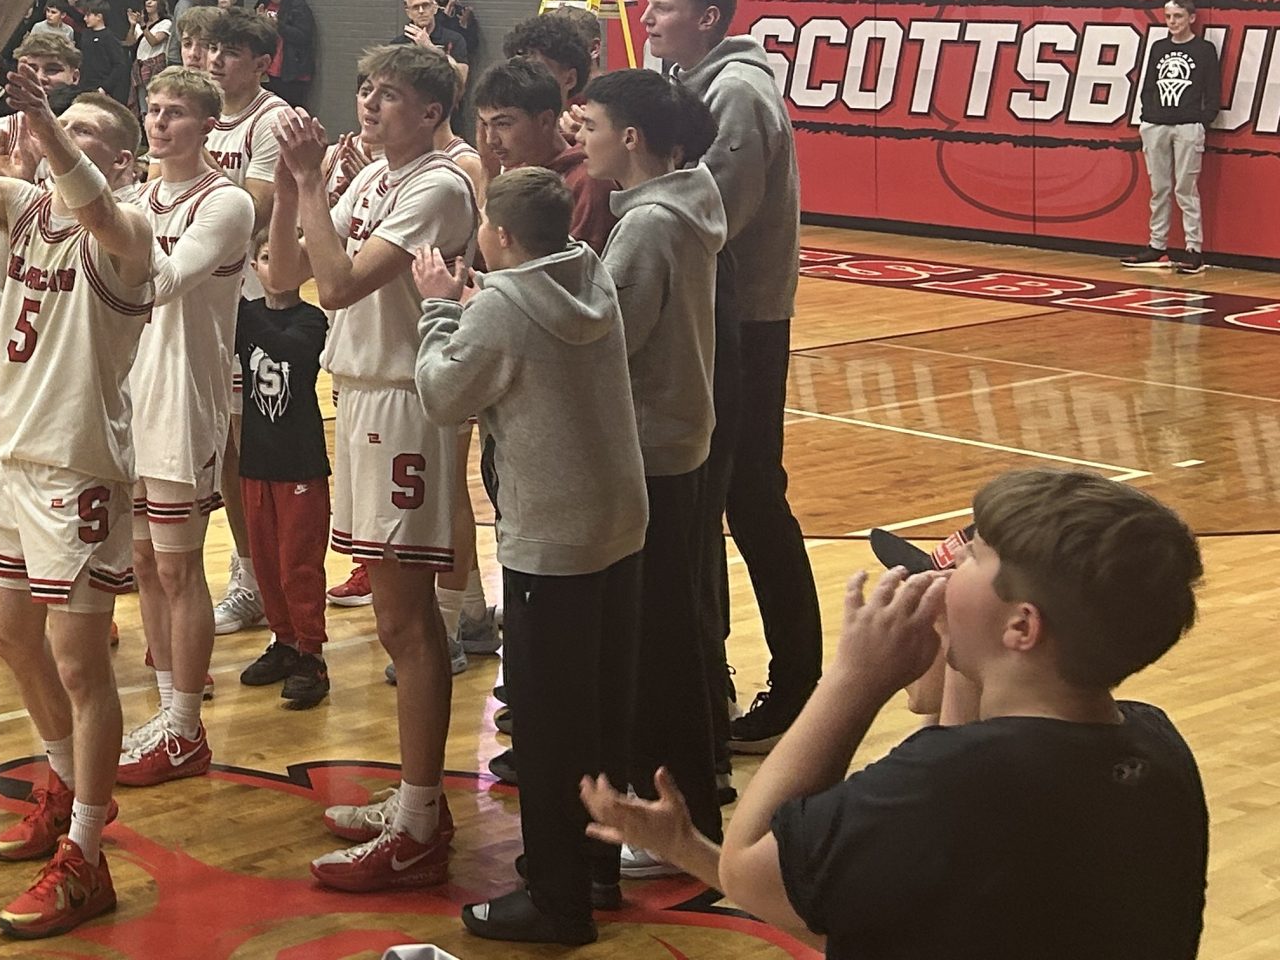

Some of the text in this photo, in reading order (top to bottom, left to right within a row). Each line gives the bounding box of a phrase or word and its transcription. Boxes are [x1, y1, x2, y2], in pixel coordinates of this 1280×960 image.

[7, 297, 41, 363] 5
[258, 356, 282, 397] S
[391, 453, 426, 510] S
[78, 486, 110, 544] S
